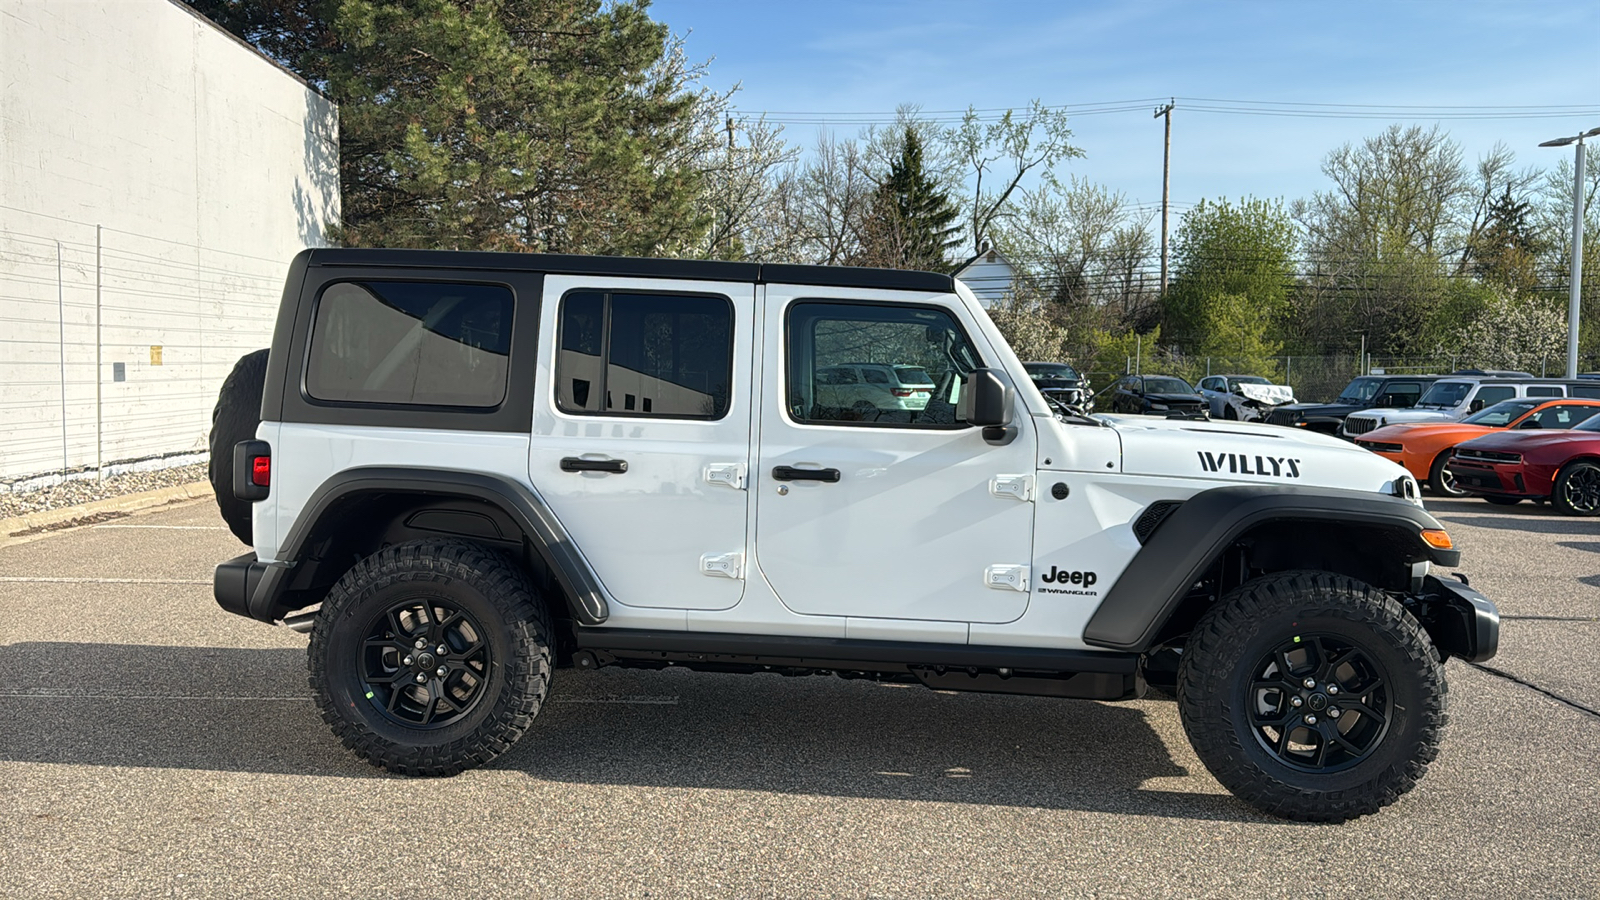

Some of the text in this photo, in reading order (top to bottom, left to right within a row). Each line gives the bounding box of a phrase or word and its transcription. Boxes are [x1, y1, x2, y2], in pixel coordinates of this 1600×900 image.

[1197, 451, 1301, 478] WILLYS
[1041, 566, 1097, 588] Jeep
[1047, 588, 1097, 596] WRANGLER
